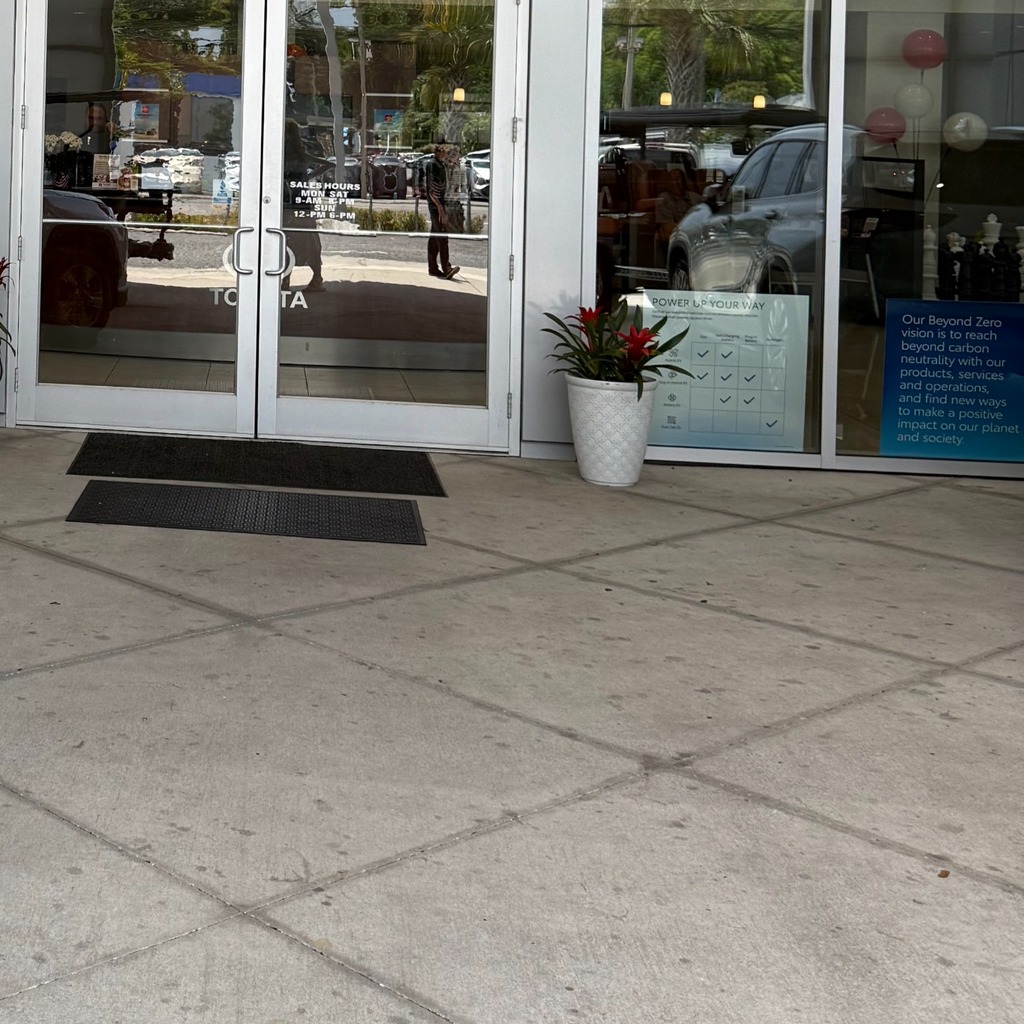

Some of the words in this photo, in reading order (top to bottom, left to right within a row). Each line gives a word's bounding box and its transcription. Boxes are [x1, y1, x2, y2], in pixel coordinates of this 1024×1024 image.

[290, 181, 322, 189] SALES
[209, 288, 308, 308] TOTA
[652, 298, 689, 307] POWER
[710, 301, 738, 309] YOUR
[742, 302, 765, 310] WAY
[902, 315, 925, 324] Our
[929, 315, 972, 327] Beyond
[976, 317, 1002, 327] Zero
[902, 328, 933, 338] vision
[938, 329, 946, 338] is
[950, 330, 961, 339] to
[966, 331, 997, 340] reach
[902, 341, 944, 353] beyond
[949, 343, 989, 353] carbon
[901, 355, 955, 367] neutrality
[958, 357, 982, 366] with
[986, 359, 1006, 367] our
[900, 368, 954, 379] products,
[959, 371, 1004, 380] services
[900, 381, 921, 390] and
[926, 383, 989, 394] operations,
[899, 394, 921, 403] and
[926, 394, 947, 404] find
[951, 396, 975, 405] new
[979, 398, 1007, 408] ways
[899, 407, 910, 416] to
[914, 407, 944, 417] make
[959, 410, 1003, 420] positive
[898, 419, 937, 431] impact
[941, 422, 955, 430] on
[959, 423, 977, 431] our
[982, 423, 1019, 434] planet
[897, 433, 919, 442] and
